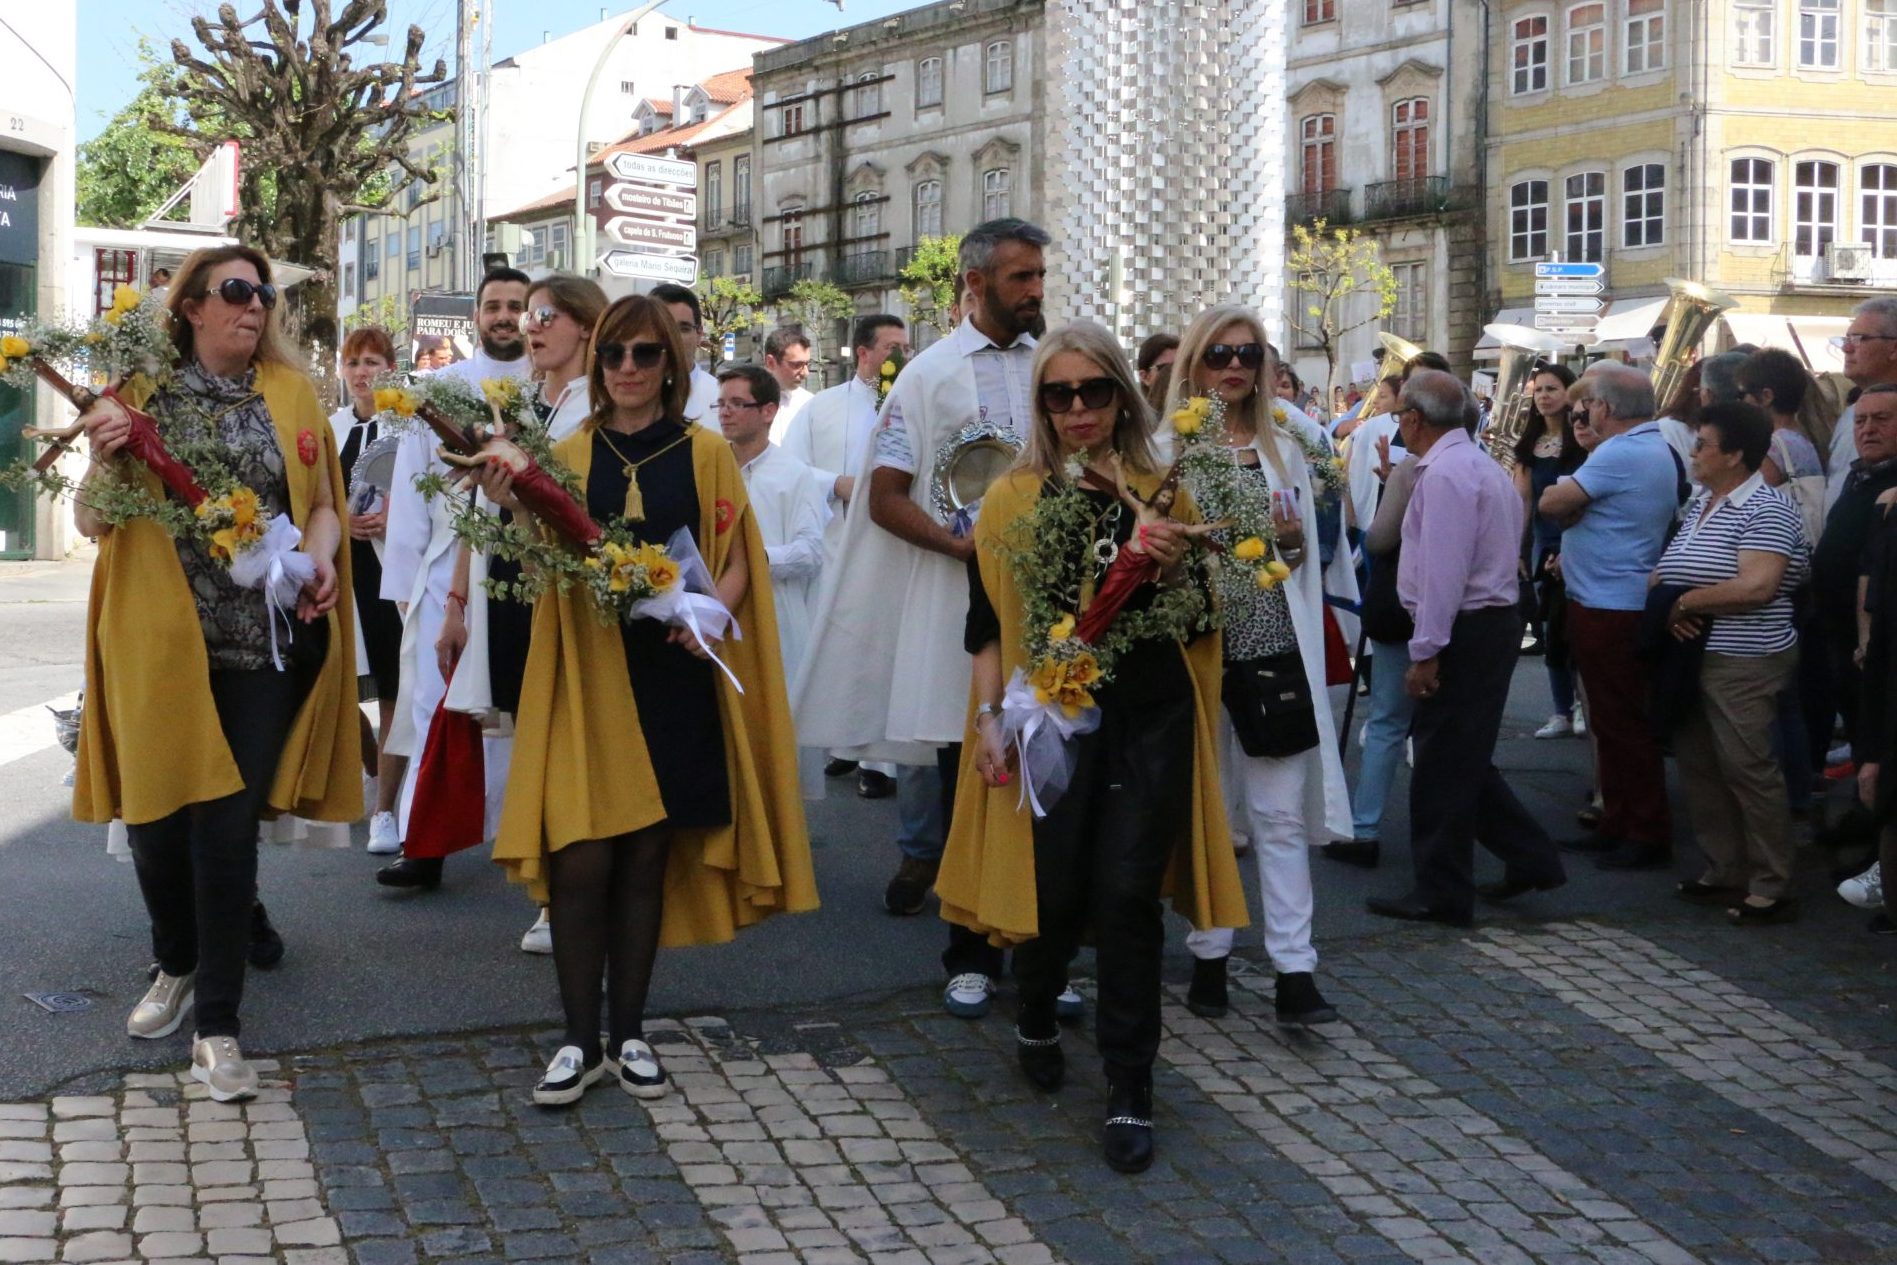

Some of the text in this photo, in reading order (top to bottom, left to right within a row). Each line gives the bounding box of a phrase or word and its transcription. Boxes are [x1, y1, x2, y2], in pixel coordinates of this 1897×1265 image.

[10, 117, 24, 131] 22
[623, 160, 645, 171] todas
[647, 164, 657, 172] as
[621, 193, 652, 204] mosteiro
[652, 196, 661, 205] de
[623, 226, 643, 236] capela
[643, 228, 651, 237] de
[613, 258, 639, 269] galeria
[663, 262, 693, 275] Sequeira
[416, 317, 452, 328] ROMEU
[453, 320, 461, 329] E
[416, 327, 467, 337] PARA DOIS
